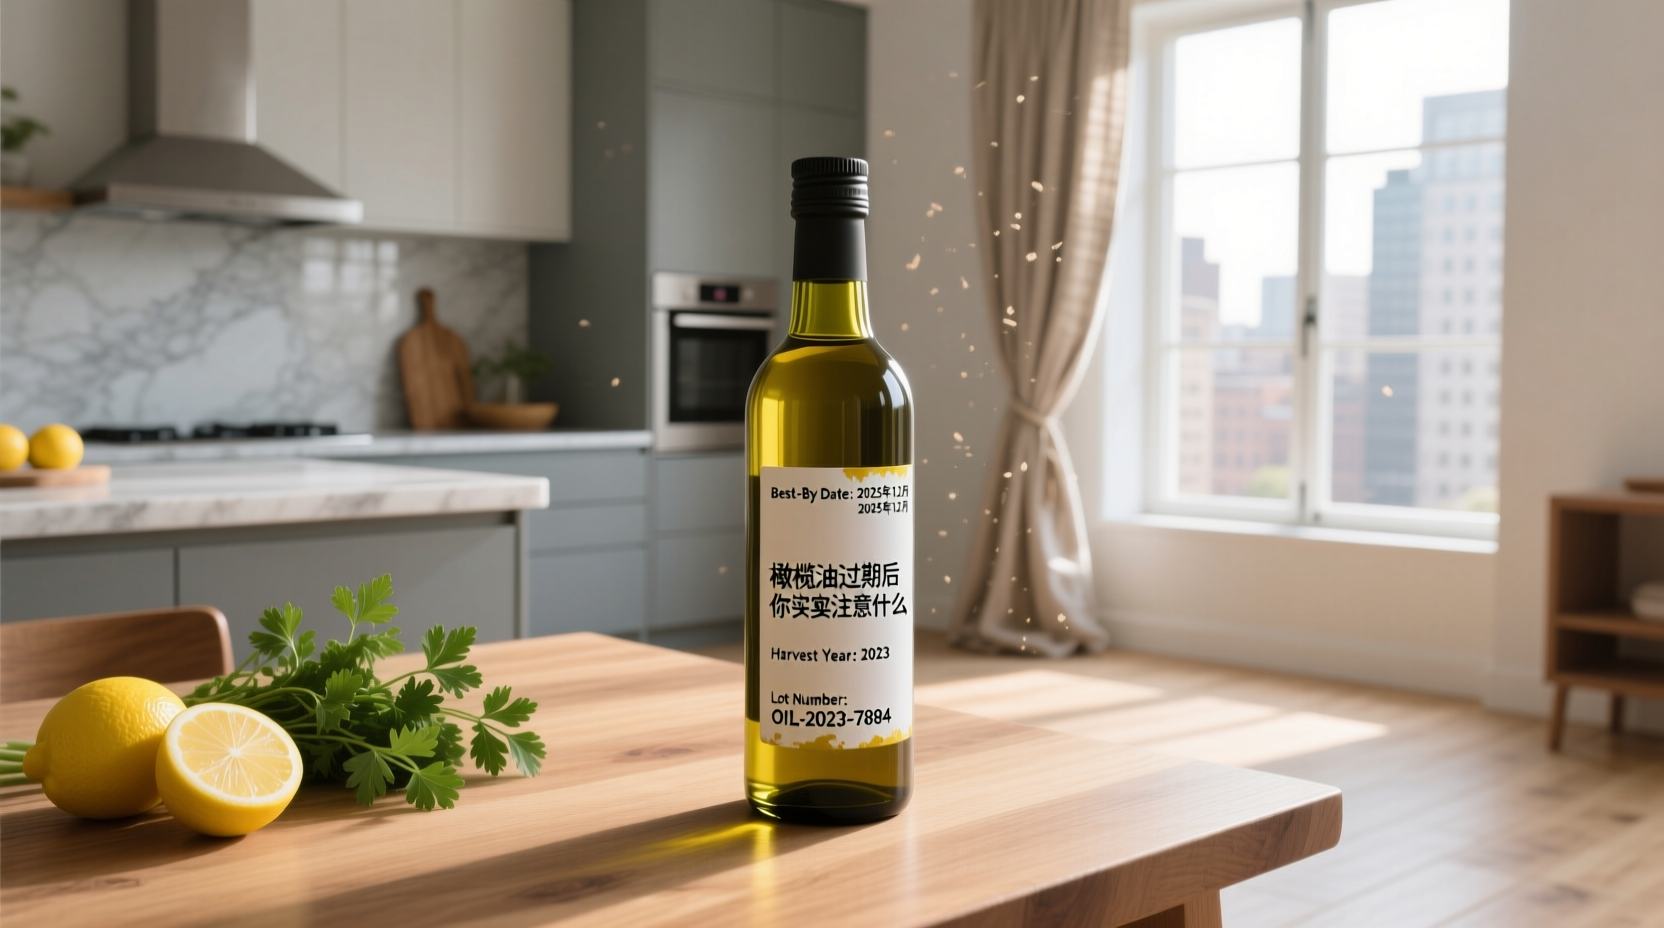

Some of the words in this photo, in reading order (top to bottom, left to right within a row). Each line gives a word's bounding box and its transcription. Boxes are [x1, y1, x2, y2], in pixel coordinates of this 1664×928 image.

[770, 486, 818, 504] Best-By
[820, 487, 854, 500] Date:
[771, 647, 818, 662] Harvest
[822, 648, 857, 662] Year:
[861, 646, 890, 661] 2023
[771, 691, 790, 705] Lot
[793, 693, 848, 706] Number:
[771, 708, 892, 727] OIL-2023-7884
